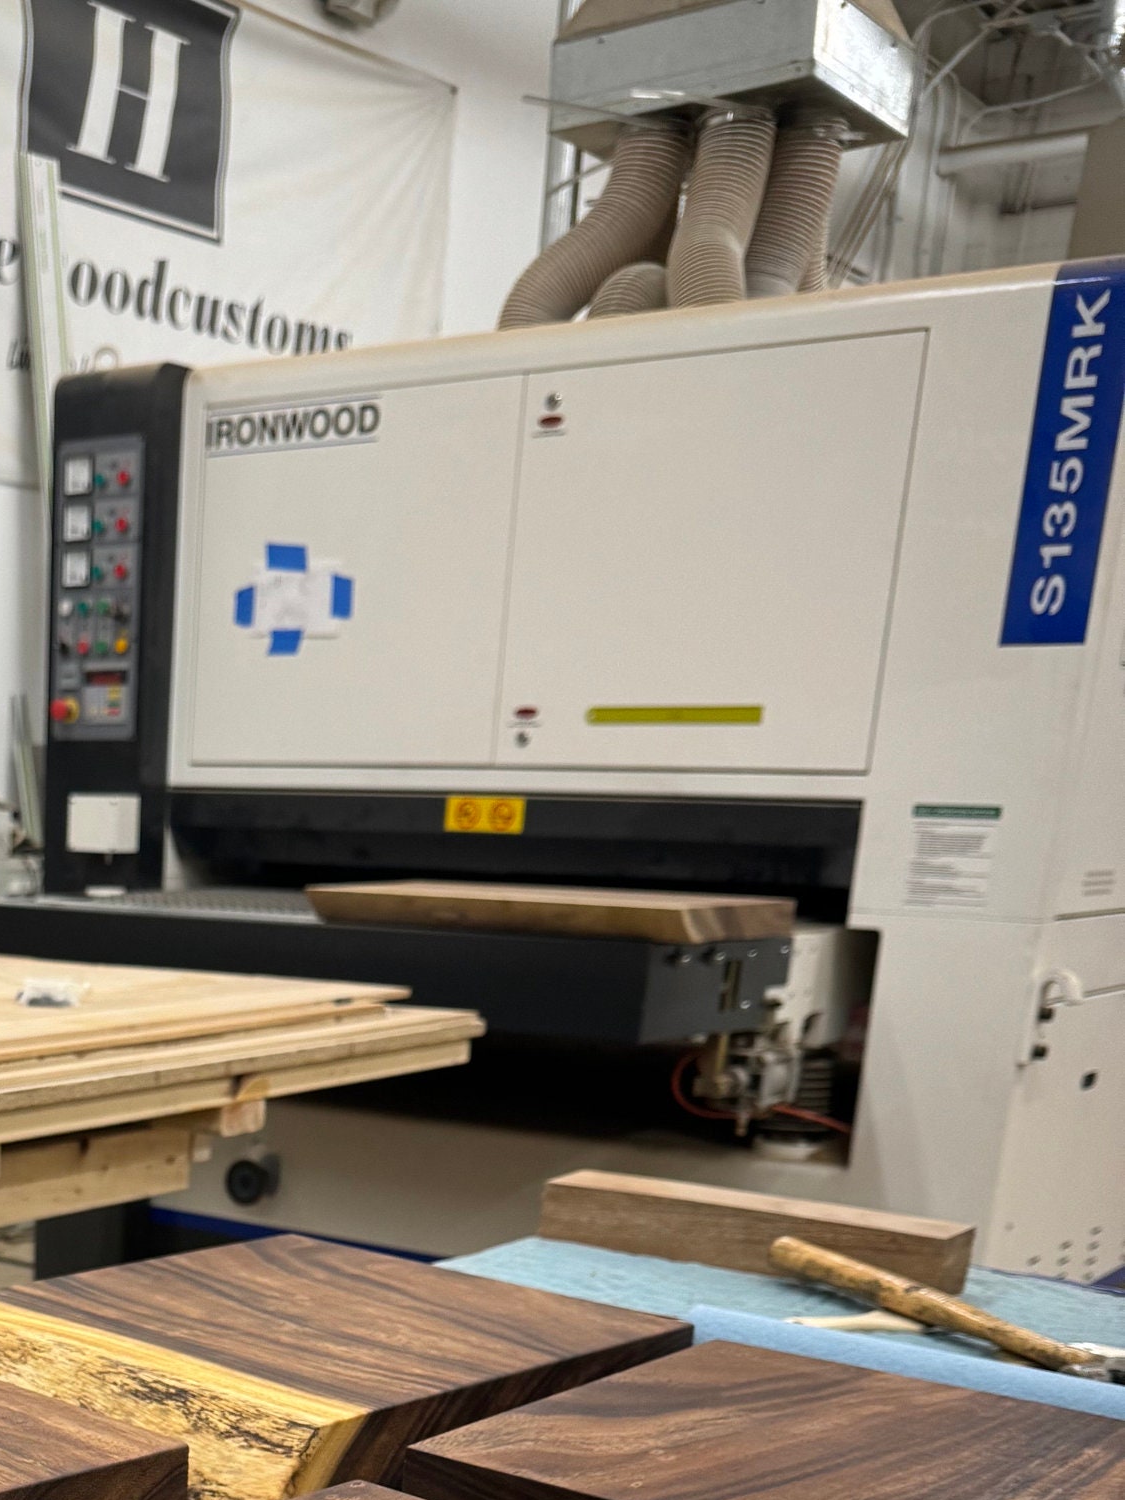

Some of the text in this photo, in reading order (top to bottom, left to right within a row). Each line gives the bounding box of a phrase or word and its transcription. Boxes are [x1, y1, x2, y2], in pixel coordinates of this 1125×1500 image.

[66, 1, 191, 183] H
[205, 403, 380, 449] IRONWOOD
[1030, 288, 1112, 617] S135MRK
